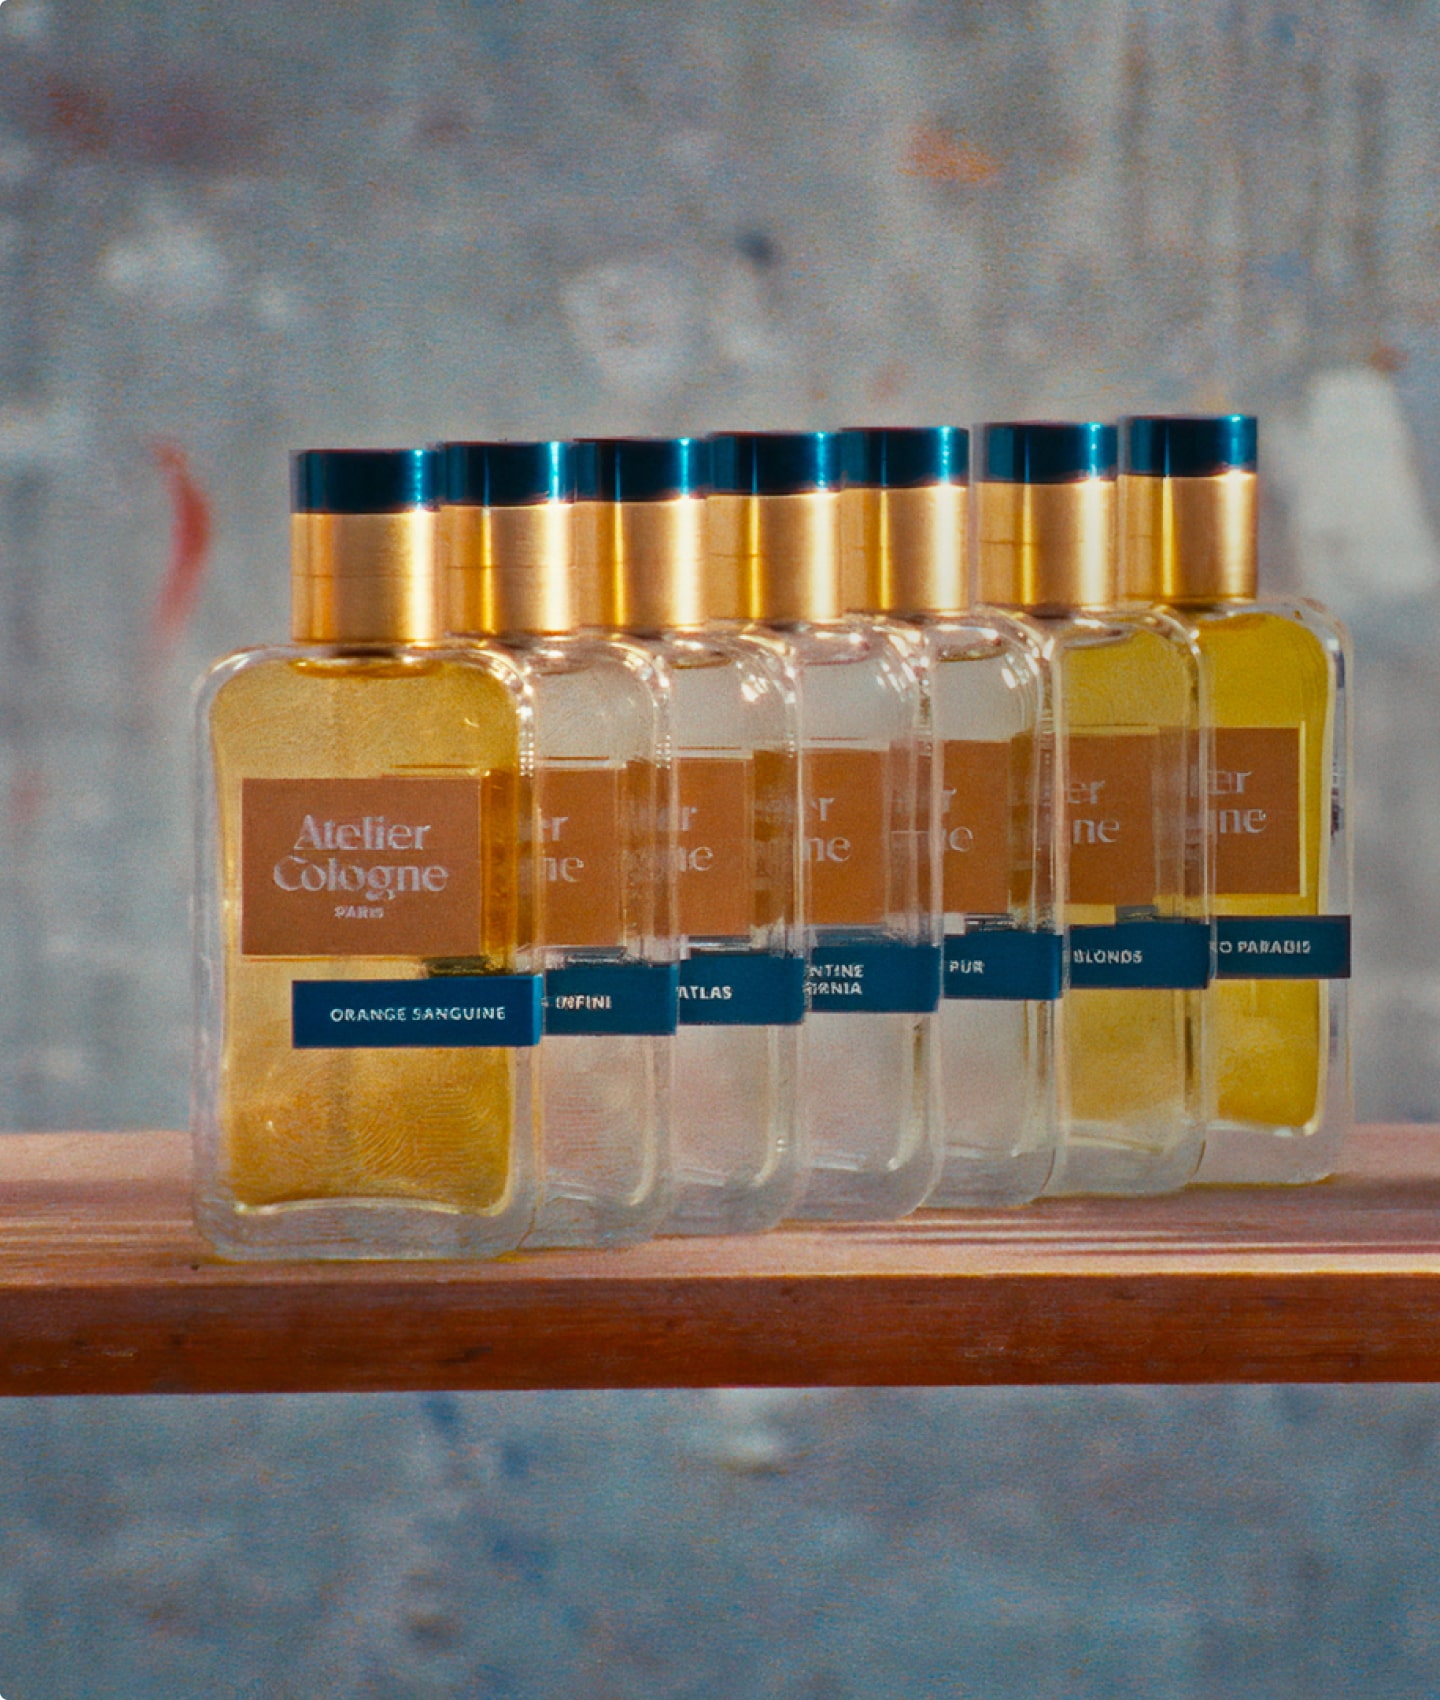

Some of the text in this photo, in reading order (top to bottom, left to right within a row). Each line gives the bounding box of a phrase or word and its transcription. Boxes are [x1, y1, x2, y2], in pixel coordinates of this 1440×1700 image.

[293, 814, 432, 850] Atelier
[273, 855, 448, 901] Cologne
[333, 905, 385, 919] PARIS
[949, 959, 984, 974] PUR
[676, 984, 734, 1000] ATLAS
[329, 1005, 507, 1022] ORANGE SANGUINE
